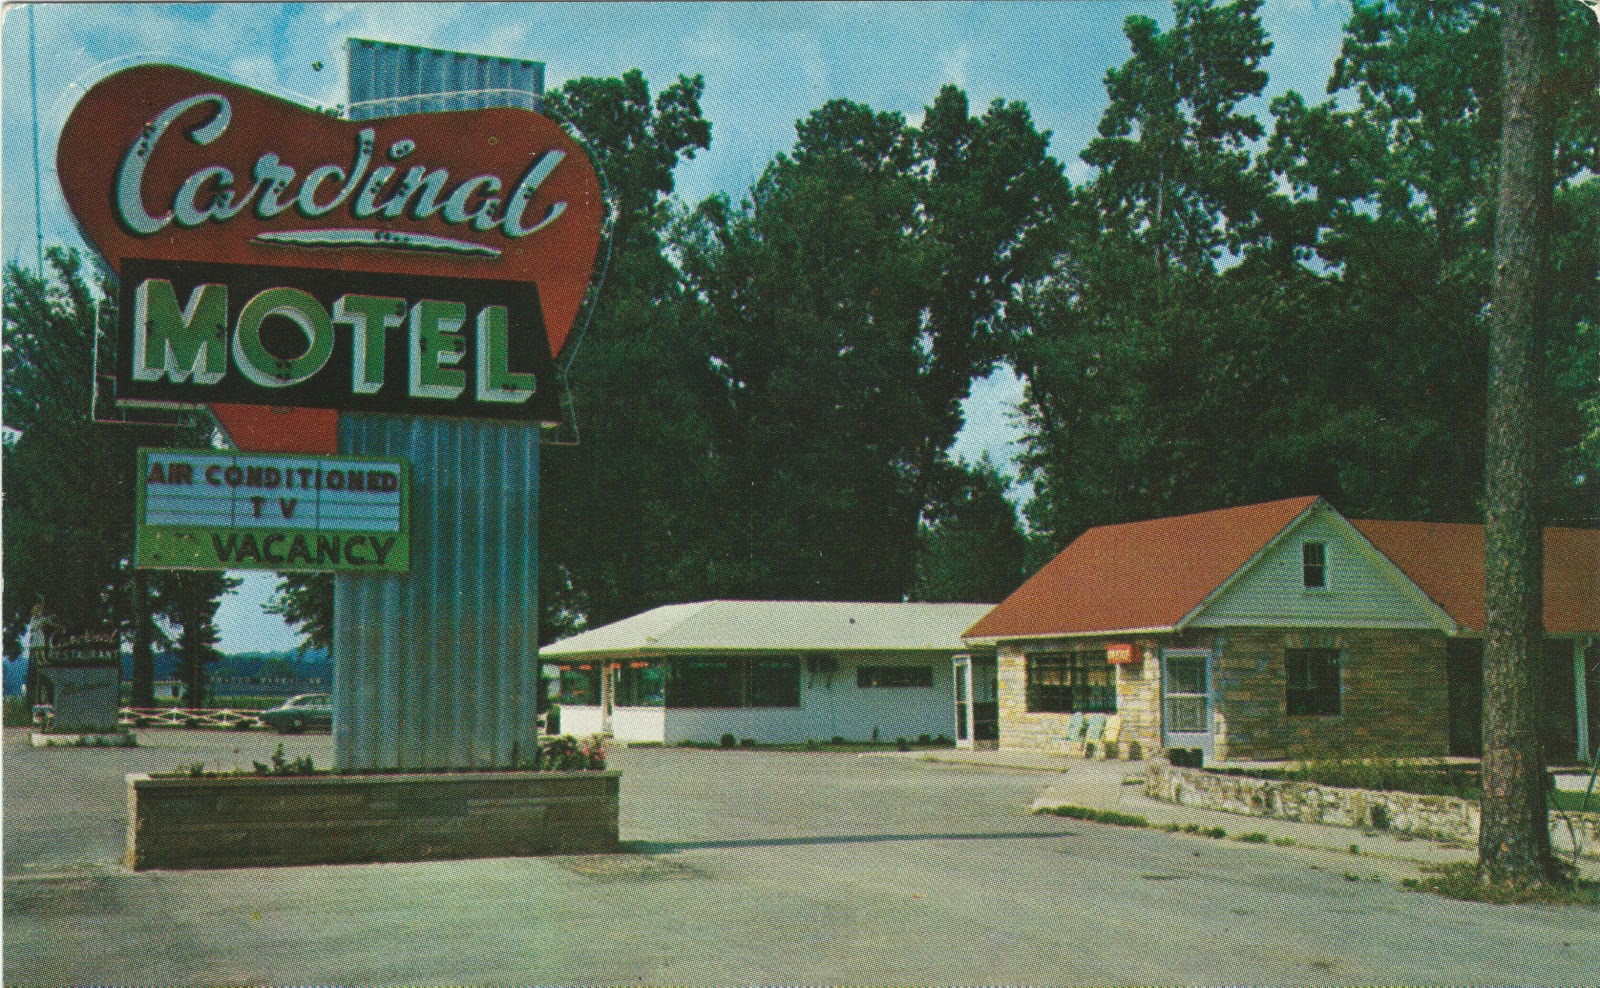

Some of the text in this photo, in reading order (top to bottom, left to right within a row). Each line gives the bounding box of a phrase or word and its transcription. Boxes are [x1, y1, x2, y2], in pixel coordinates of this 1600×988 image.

[115, 92, 568, 238] Cardinal
[131, 278, 537, 403] MOTEL
[148, 461, 398, 492] AIR CONDITIONED
[211, 532, 397, 565] VACANCY
